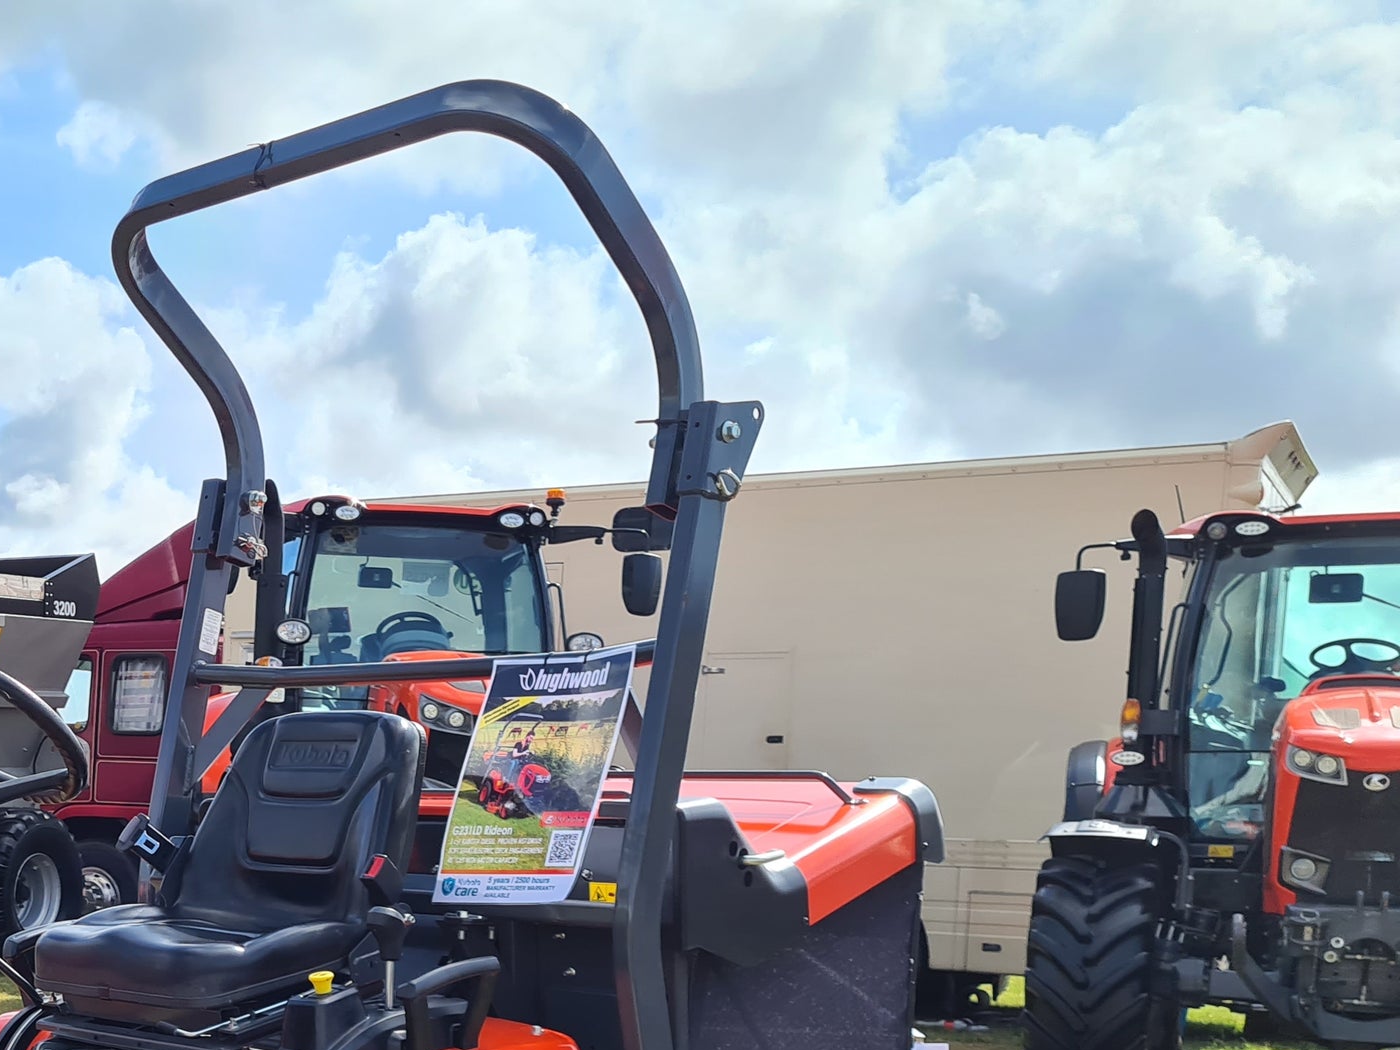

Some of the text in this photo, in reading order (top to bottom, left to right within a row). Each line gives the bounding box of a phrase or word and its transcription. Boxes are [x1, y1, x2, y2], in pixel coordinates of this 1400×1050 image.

[53, 600, 76, 617] 3200
[533, 661, 611, 693] highwood
[484, 824, 513, 836] Rideon
[454, 886, 479, 896] care
